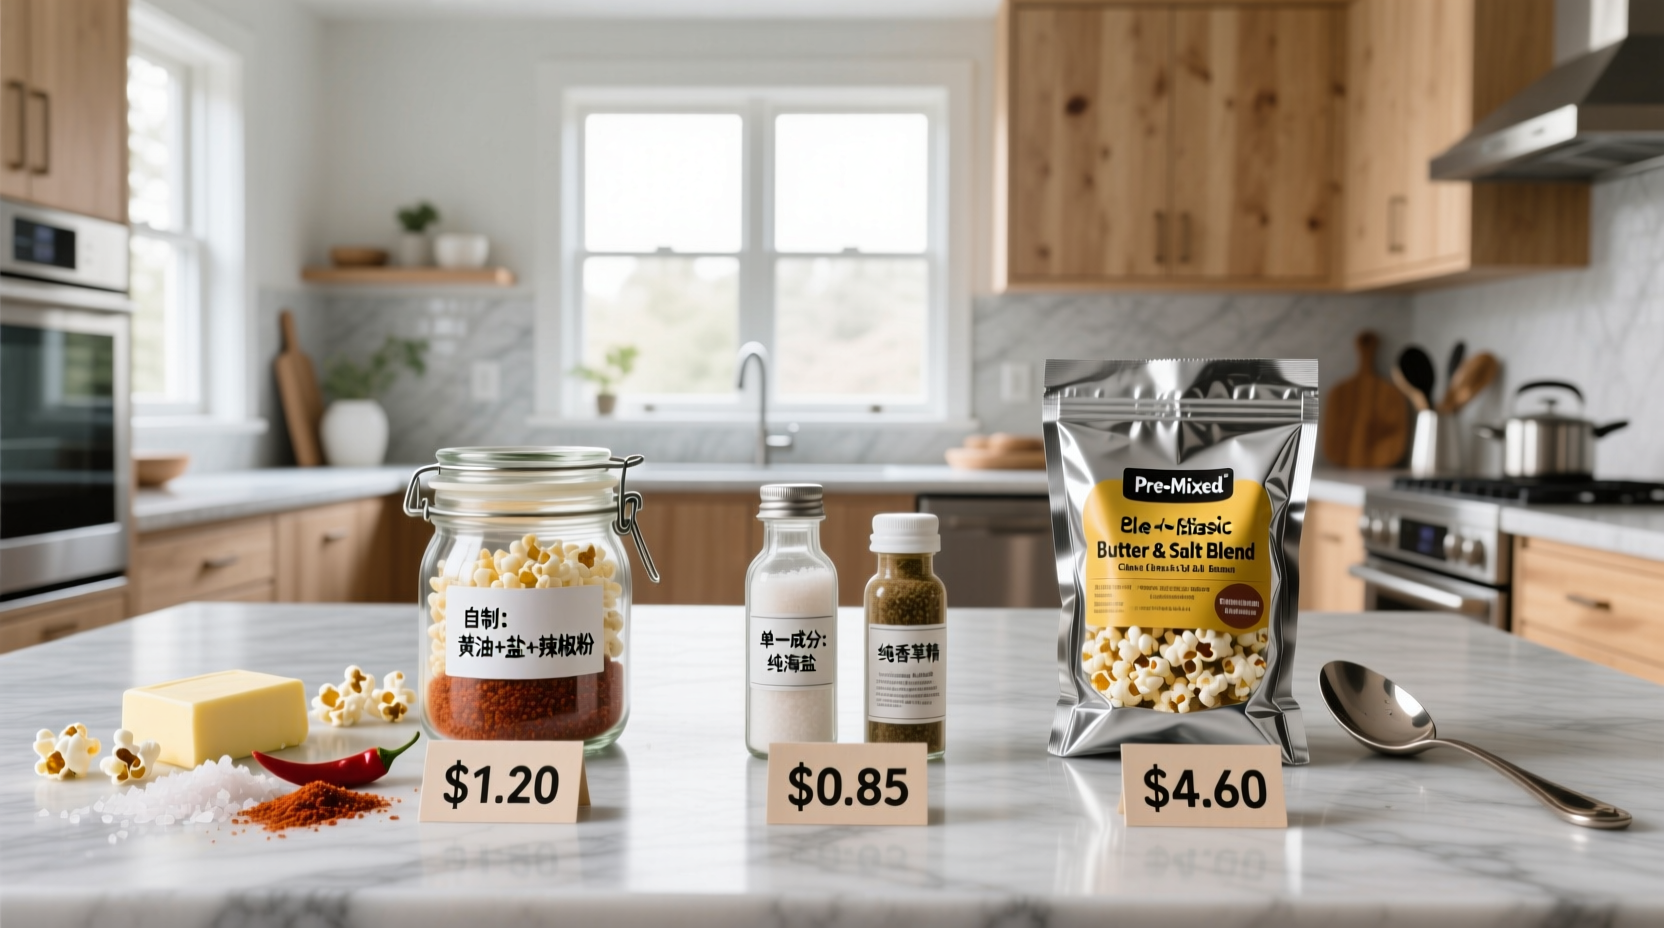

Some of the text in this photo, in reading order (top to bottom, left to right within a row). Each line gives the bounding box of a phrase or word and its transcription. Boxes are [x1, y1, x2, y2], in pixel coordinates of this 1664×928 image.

[1134, 474, 1224, 495] Pre-Mixed
[1097, 541, 1255, 560] Butter & Salt Blend
[766, 652, 817, 673] 纯海盐
[442, 759, 560, 810] $1.20
[787, 761, 910, 812] $0.85
[1143, 763, 1268, 813] $4.60
